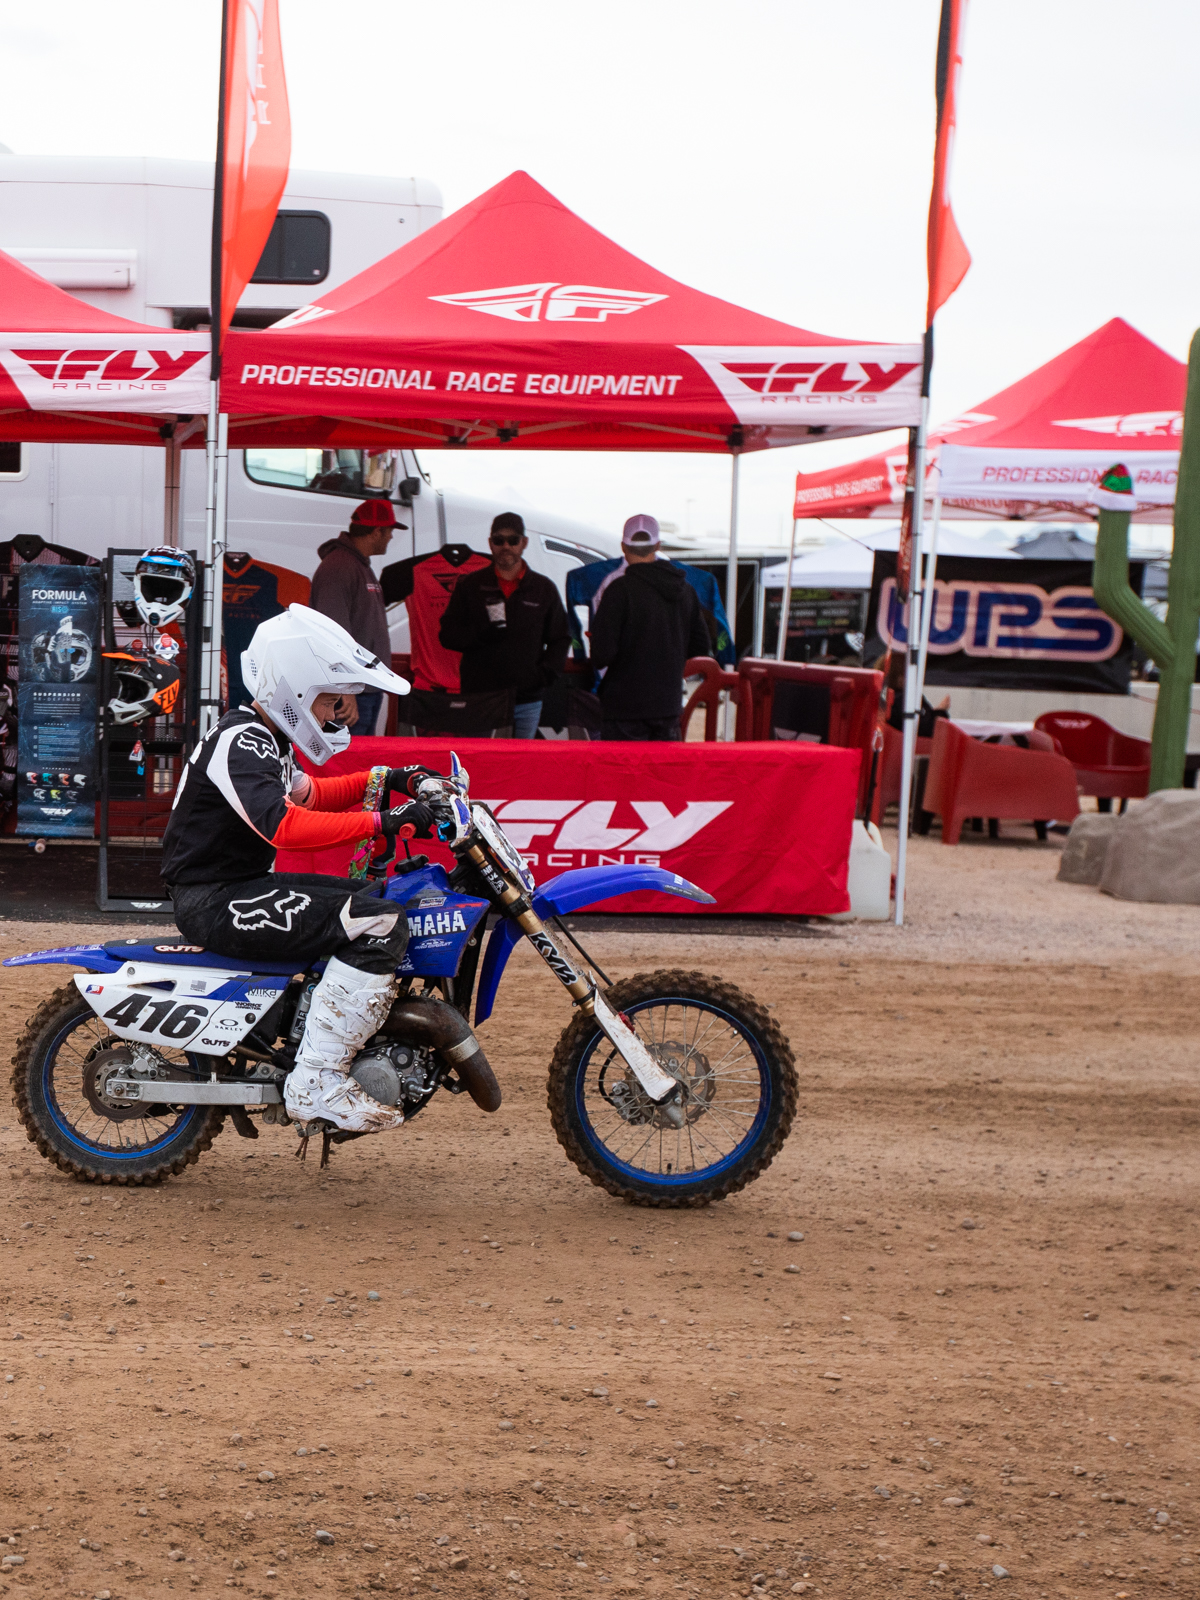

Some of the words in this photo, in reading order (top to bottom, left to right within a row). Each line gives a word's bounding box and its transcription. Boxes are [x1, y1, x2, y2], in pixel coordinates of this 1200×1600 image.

[9, 348, 211, 380] FLY
[52, 383, 167, 391] RACING
[240, 364, 437, 391] PROFESSIONAL
[445, 370, 518, 393] RACE
[525, 373, 683, 397] EQUIPMENT
[720, 362, 922, 393] FLY
[761, 395, 877, 404] RACING
[982, 466, 1106, 485] PROFESSION
[1135, 469, 1178, 485] RAC
[32, 589, 87, 600] FORMULA
[887, 586, 1114, 652] WPS
[40, 807, 73, 816] FLY
[527, 853, 661, 867] ACING
[407, 910, 467, 938] MAHA
[155, 945, 205, 953] GUTS
[528, 931, 578, 986] KYB
[103, 993, 209, 1039] 416
[201, 1038, 231, 1047] GUTS
